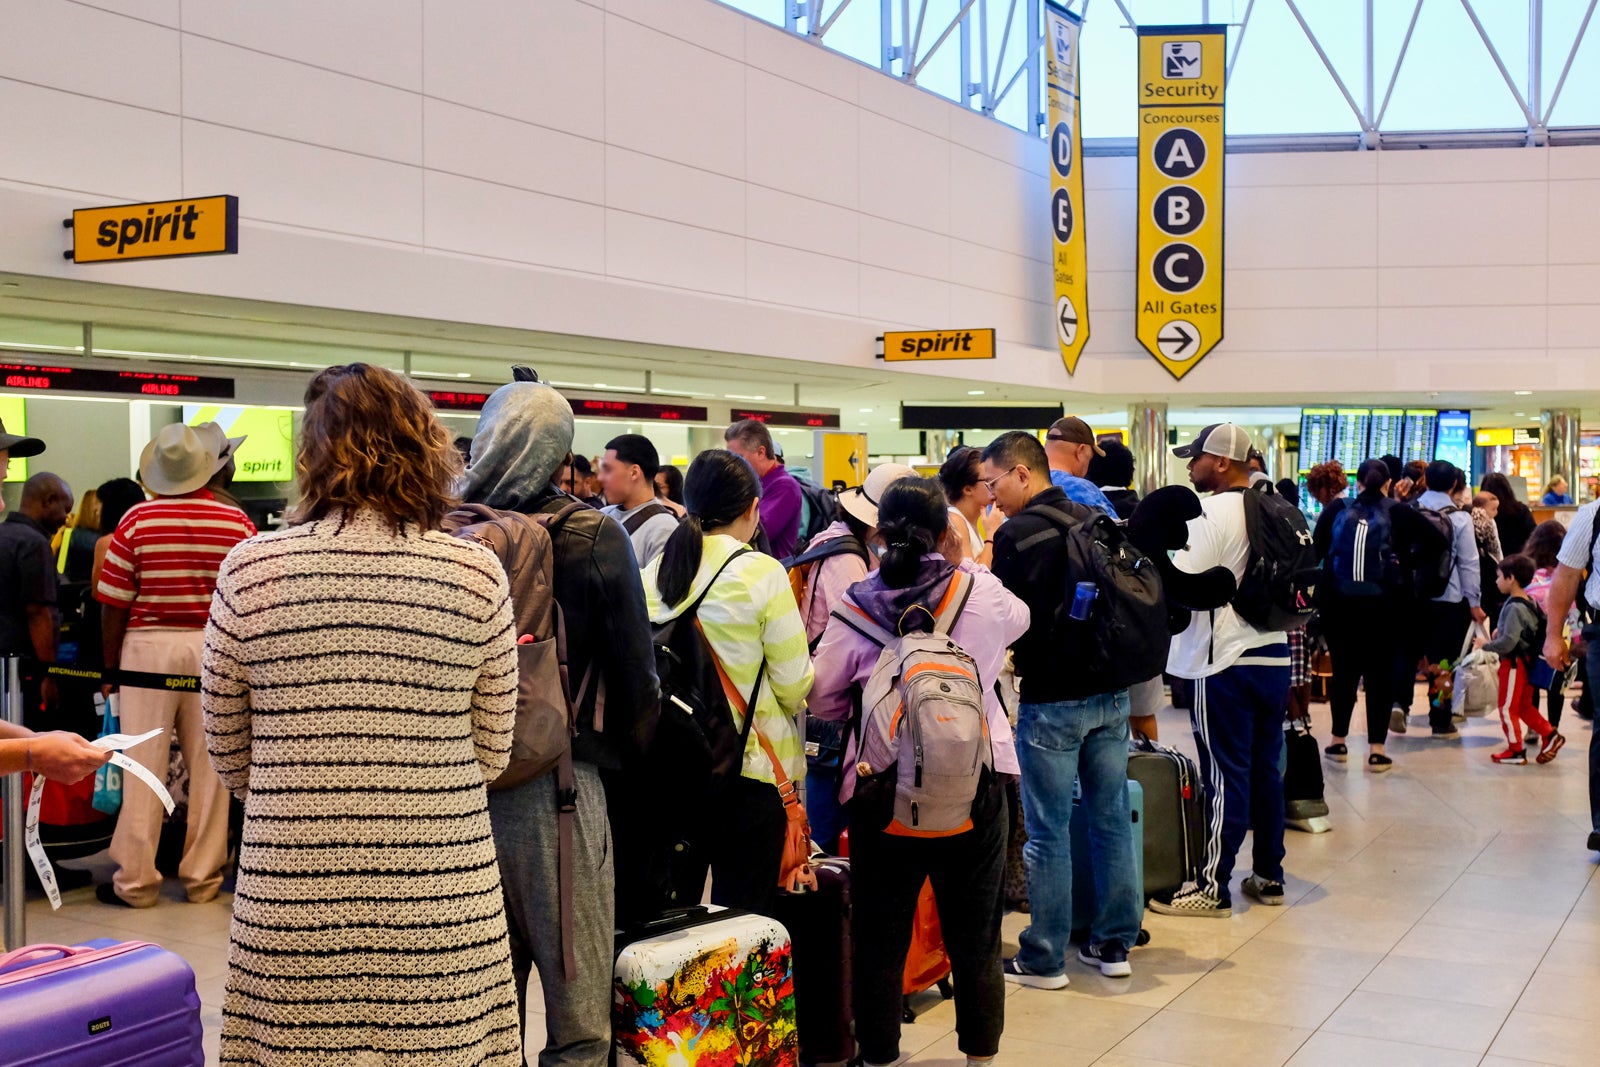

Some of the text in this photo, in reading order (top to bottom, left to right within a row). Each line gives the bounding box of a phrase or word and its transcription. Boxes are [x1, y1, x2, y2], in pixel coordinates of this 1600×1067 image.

[1144, 82, 1218, 100] Security
[1143, 113, 1220, 124] Concourses
[1058, 132, 1071, 166] D
[1164, 138, 1195, 168] A
[1058, 198, 1068, 233] E
[1168, 196, 1191, 226] B
[97, 205, 199, 254] spirit
[1164, 252, 1190, 283] C
[1143, 301, 1217, 314] All Gates
[901, 332, 973, 357] spirit
[6, 375, 50, 388] AIRLINES
[141, 383, 179, 395] AIRLINES
[243, 459, 282, 474] spirit
[165, 676, 197, 689] spirit
